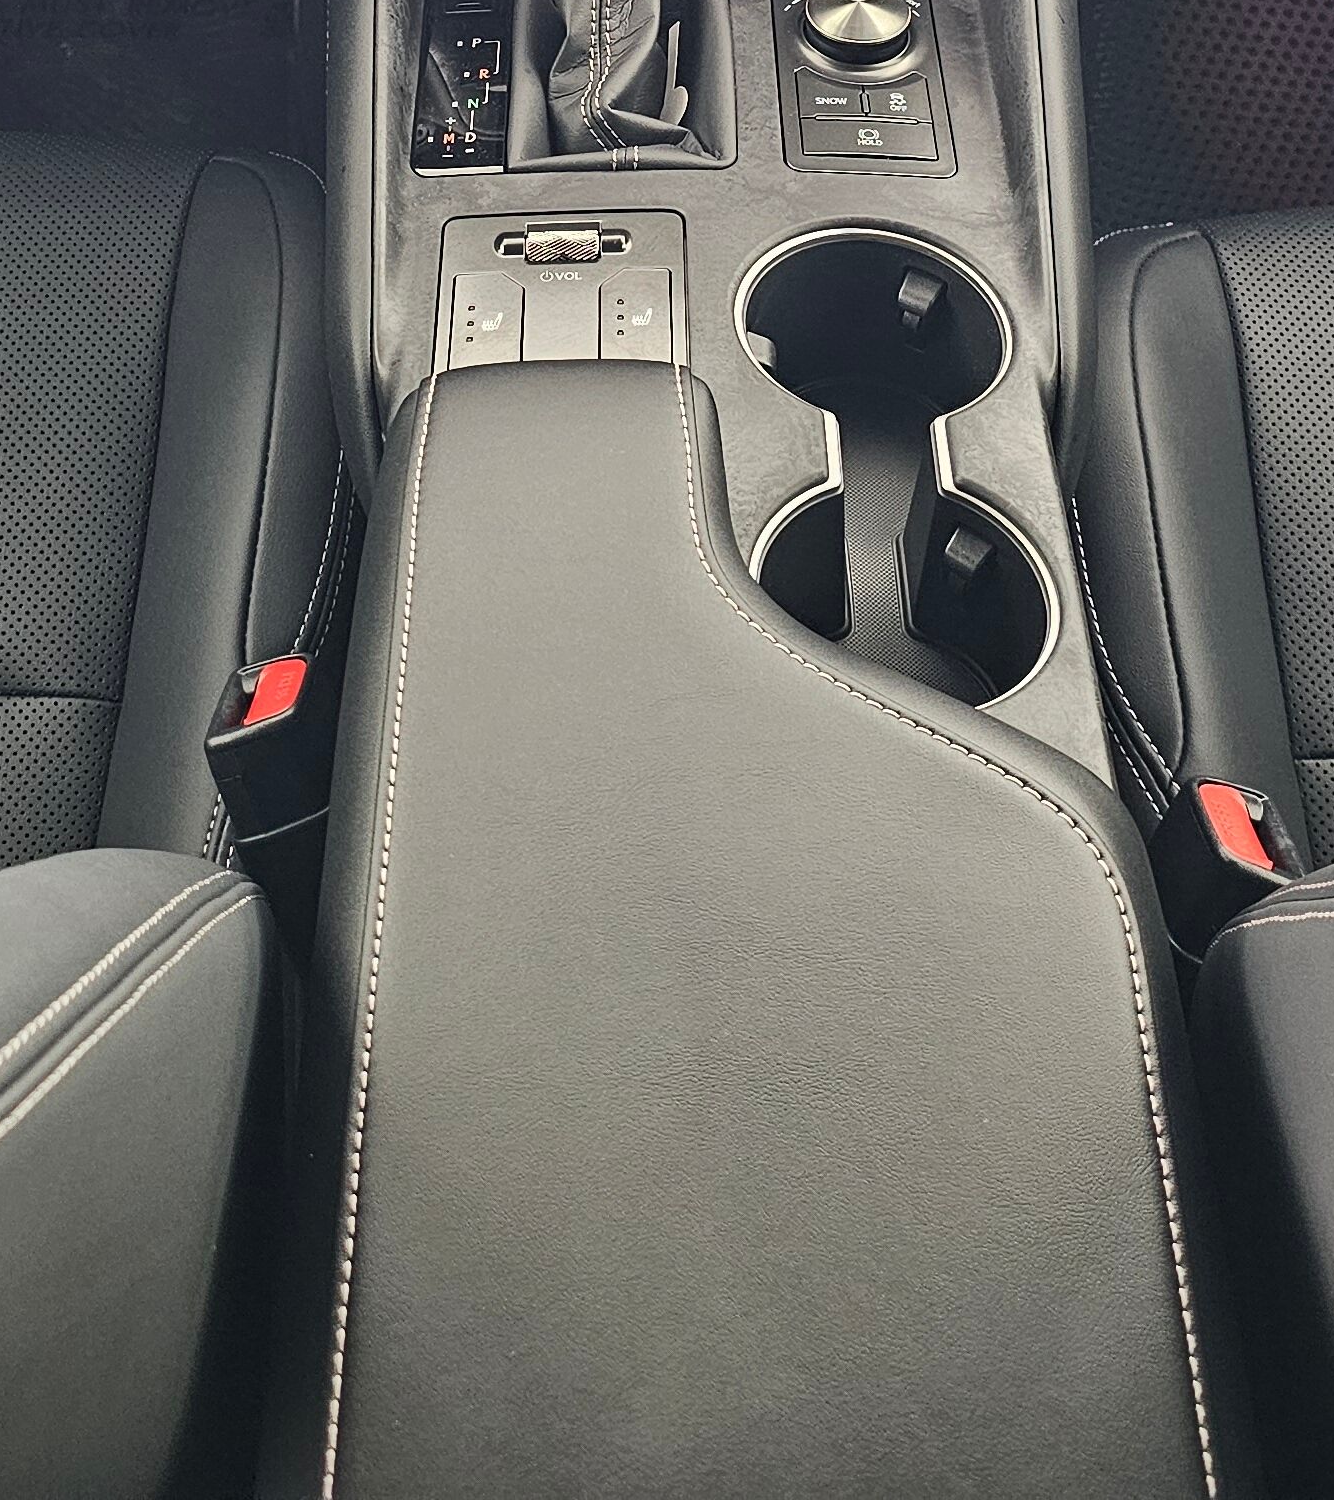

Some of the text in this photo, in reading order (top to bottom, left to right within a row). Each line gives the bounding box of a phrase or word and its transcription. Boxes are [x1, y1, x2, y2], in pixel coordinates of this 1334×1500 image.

[471, 37, 482, 49] P
[478, 68, 490, 80] R
[467, 97, 480, 109] N
[814, 96, 848, 106] SNOW
[443, 132, 477, 145] M D
[857, 138, 884, 146] HOLD
[555, 271, 583, 281] VOL
